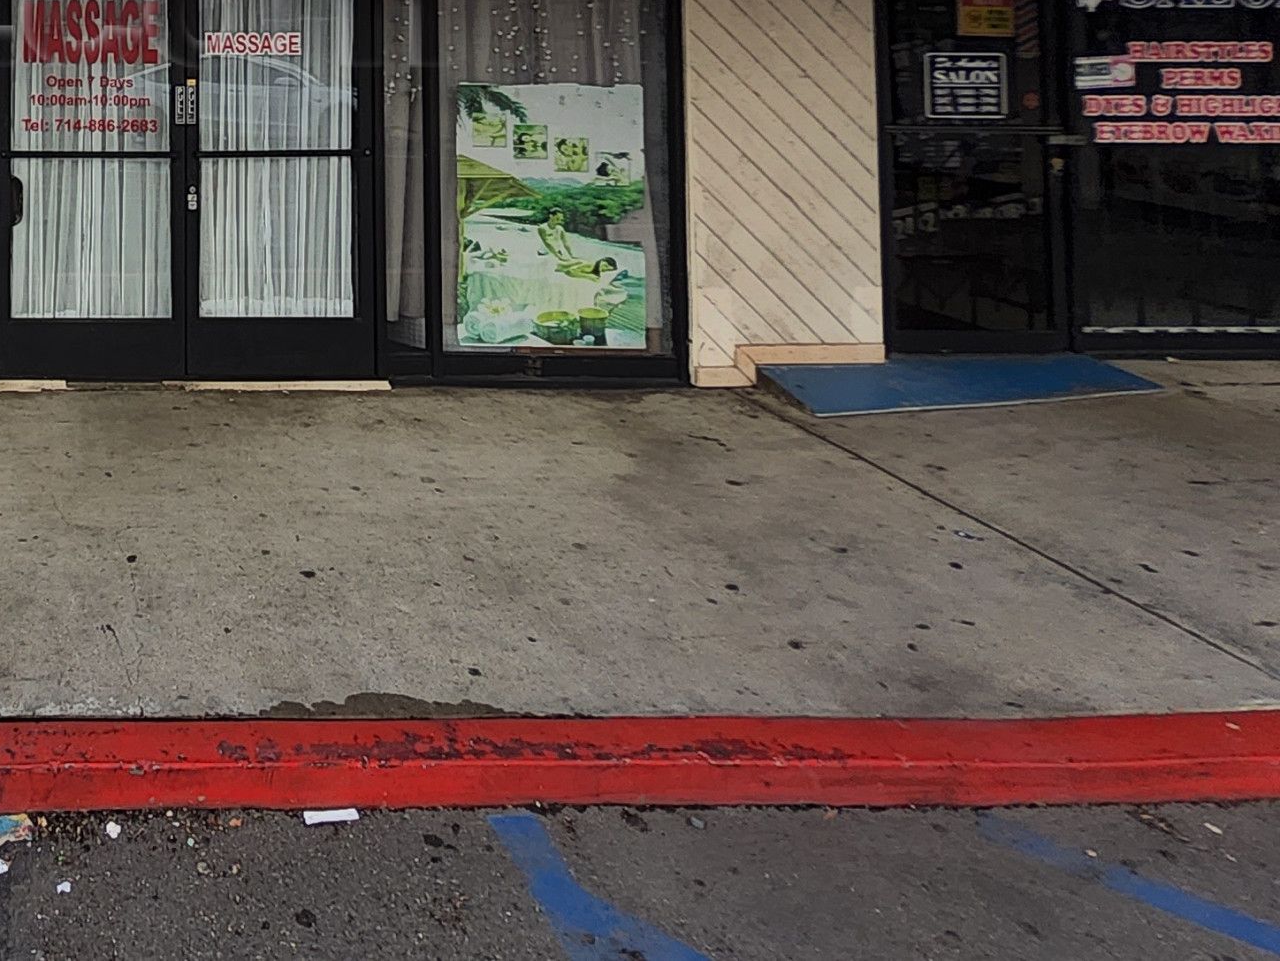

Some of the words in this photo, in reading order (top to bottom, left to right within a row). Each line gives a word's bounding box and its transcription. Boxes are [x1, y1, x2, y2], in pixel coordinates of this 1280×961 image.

[23, 0, 159, 64] MASSAGE
[205, 33, 300, 54] MASSAGE
[46, 75, 83, 89] Open
[87, 76, 95, 87] 7
[99, 75, 134, 91] Days
[932, 70, 999, 83] SALON
[1162, 69, 1241, 88] PERMS
[30, 94, 150, 108] 10:00am-10:00pm
[1175, 95, 1280, 116] HIGHLIG
[22, 118, 50, 132] Tel:
[1214, 122, 1280, 143] WAX
